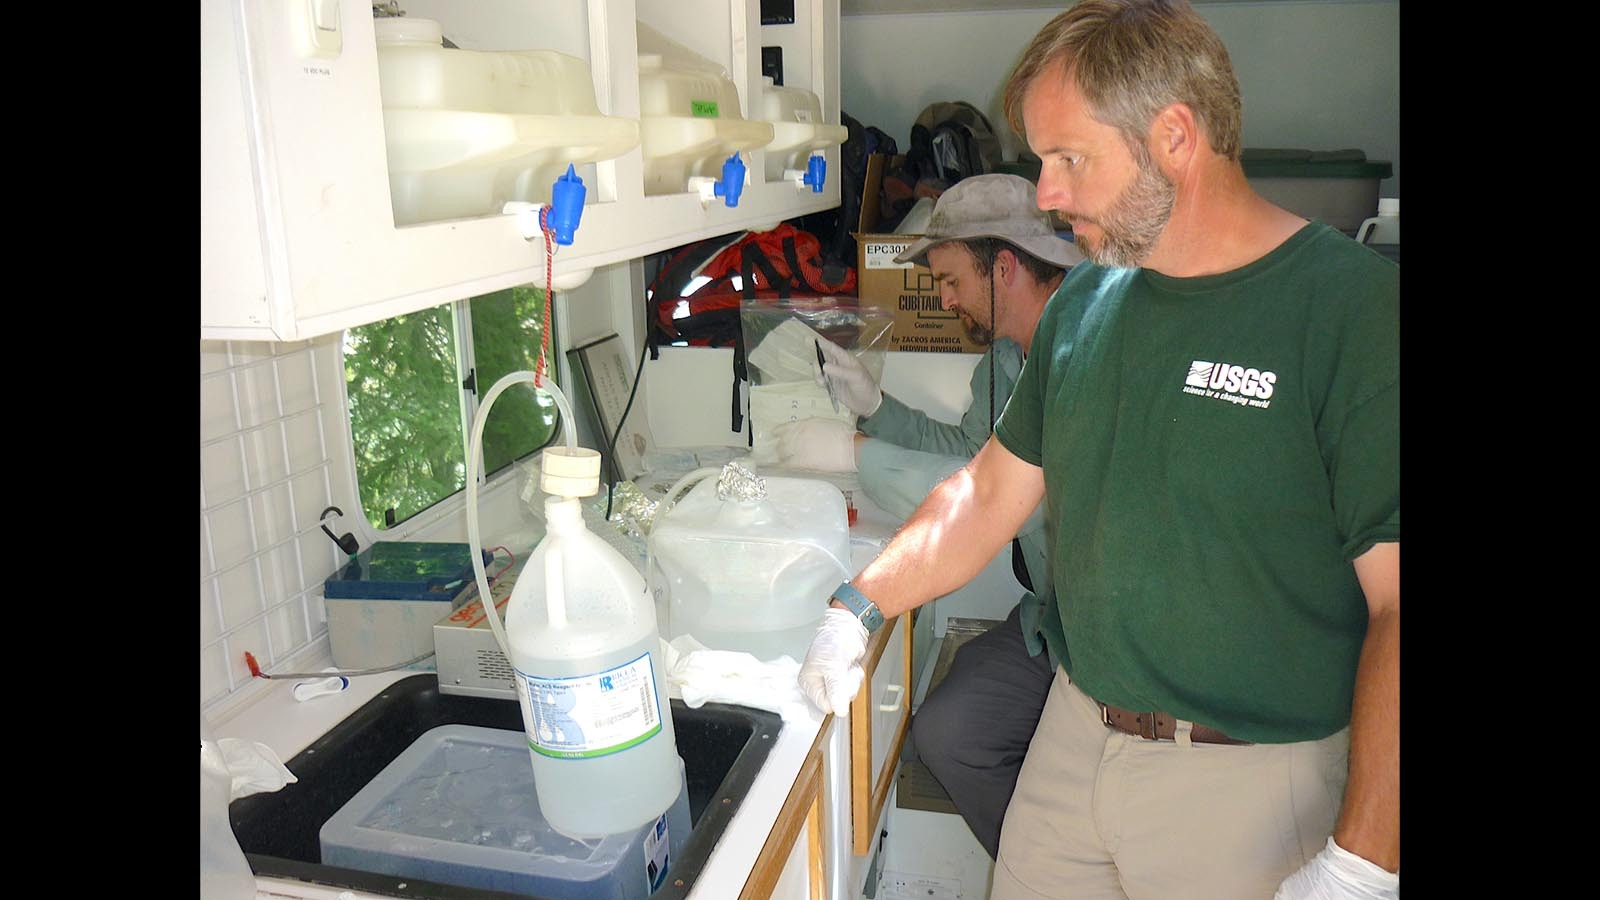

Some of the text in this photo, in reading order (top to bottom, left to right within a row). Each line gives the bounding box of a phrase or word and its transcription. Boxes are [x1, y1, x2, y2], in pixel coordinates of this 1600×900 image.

[914, 321, 944, 329] Container
[891, 335, 961, 344] by ZACROS AMERICA
[930, 345, 963, 353] DIVISION
[1208, 362, 1277, 400] USGS
[1182, 385, 1206, 397] science
[1205, 388, 1215, 398] for
[1219, 392, 1249, 407] changing
[1247, 399, 1271, 409] world
